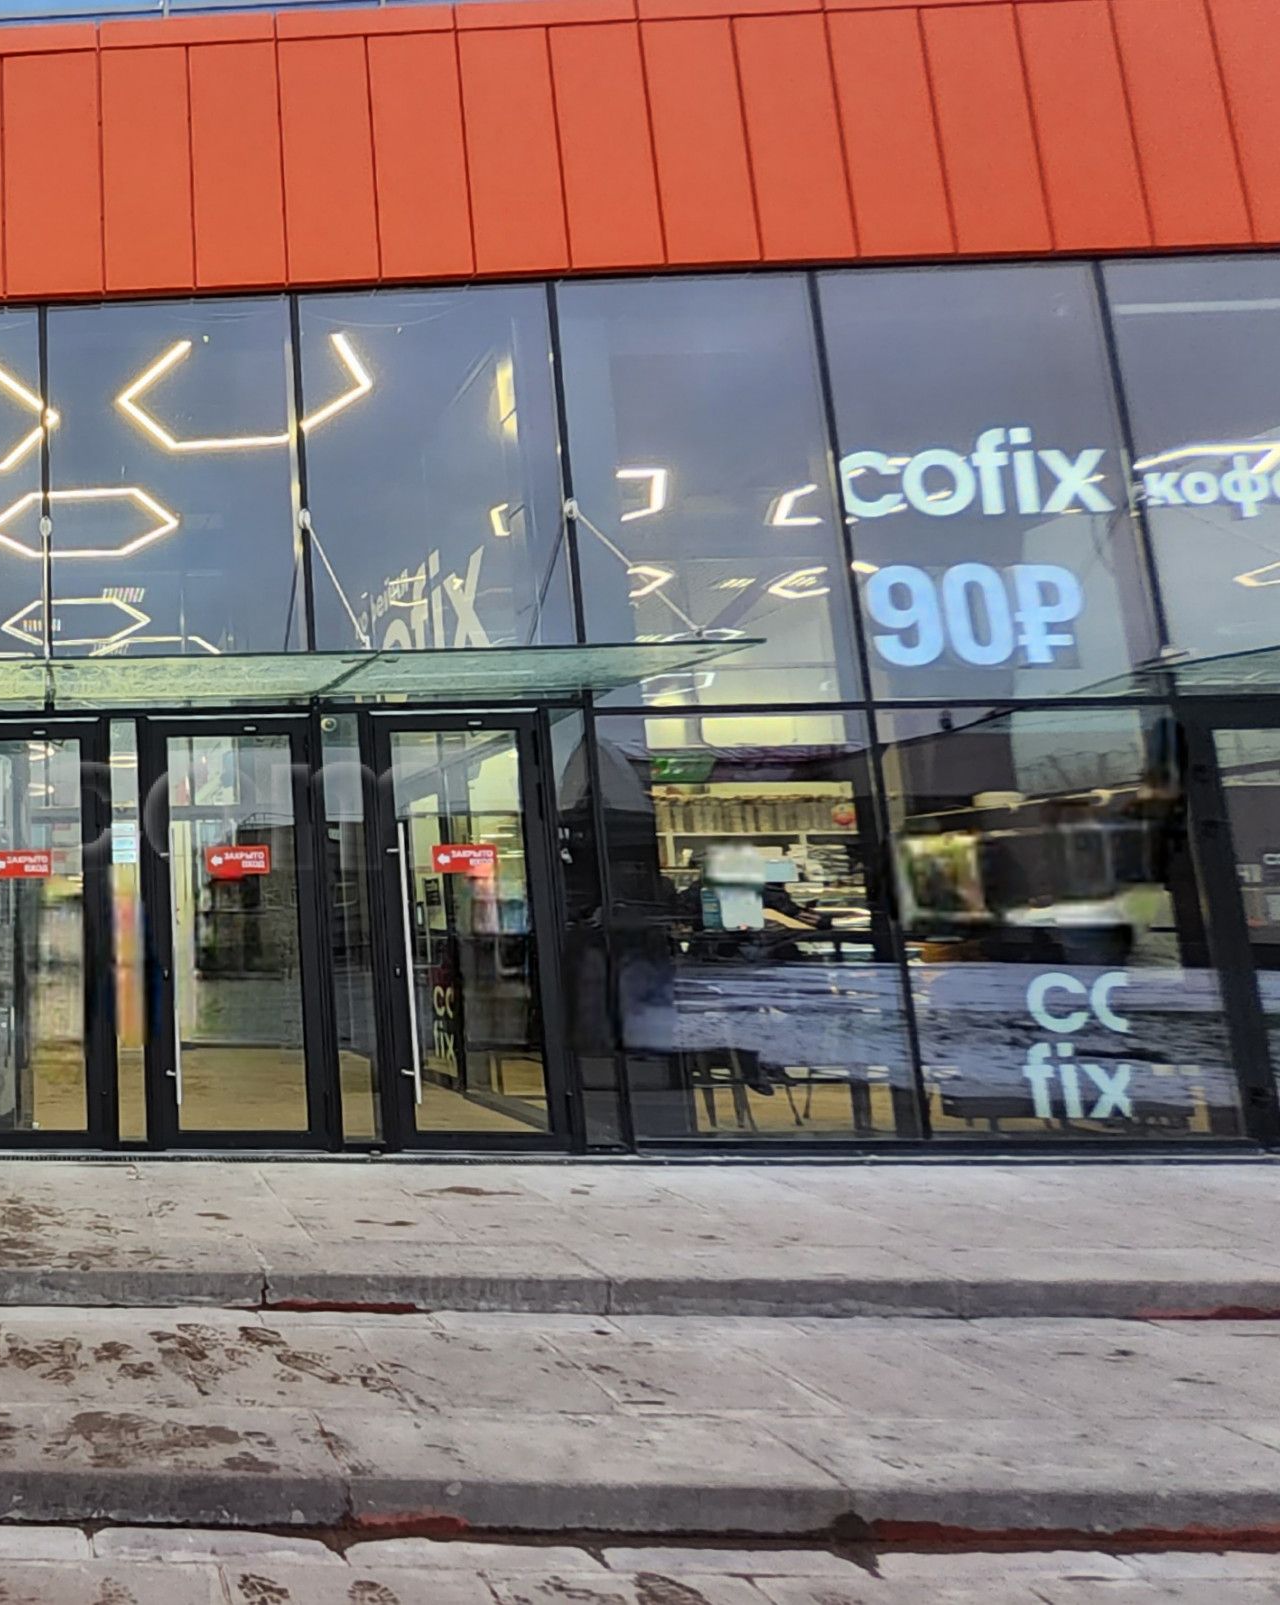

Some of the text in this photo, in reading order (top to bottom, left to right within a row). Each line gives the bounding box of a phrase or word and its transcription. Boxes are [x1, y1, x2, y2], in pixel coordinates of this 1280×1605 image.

[839, 426, 1117, 518] cofix
[1143, 454, 1280, 518] коф
[6, 855, 49, 864] ЗАКРЫТО
[223, 850, 265, 860] ЗАКРЫТО
[451, 849, 494, 859] ЗАКРЫТО
[1022, 1042, 1133, 1119] fix
